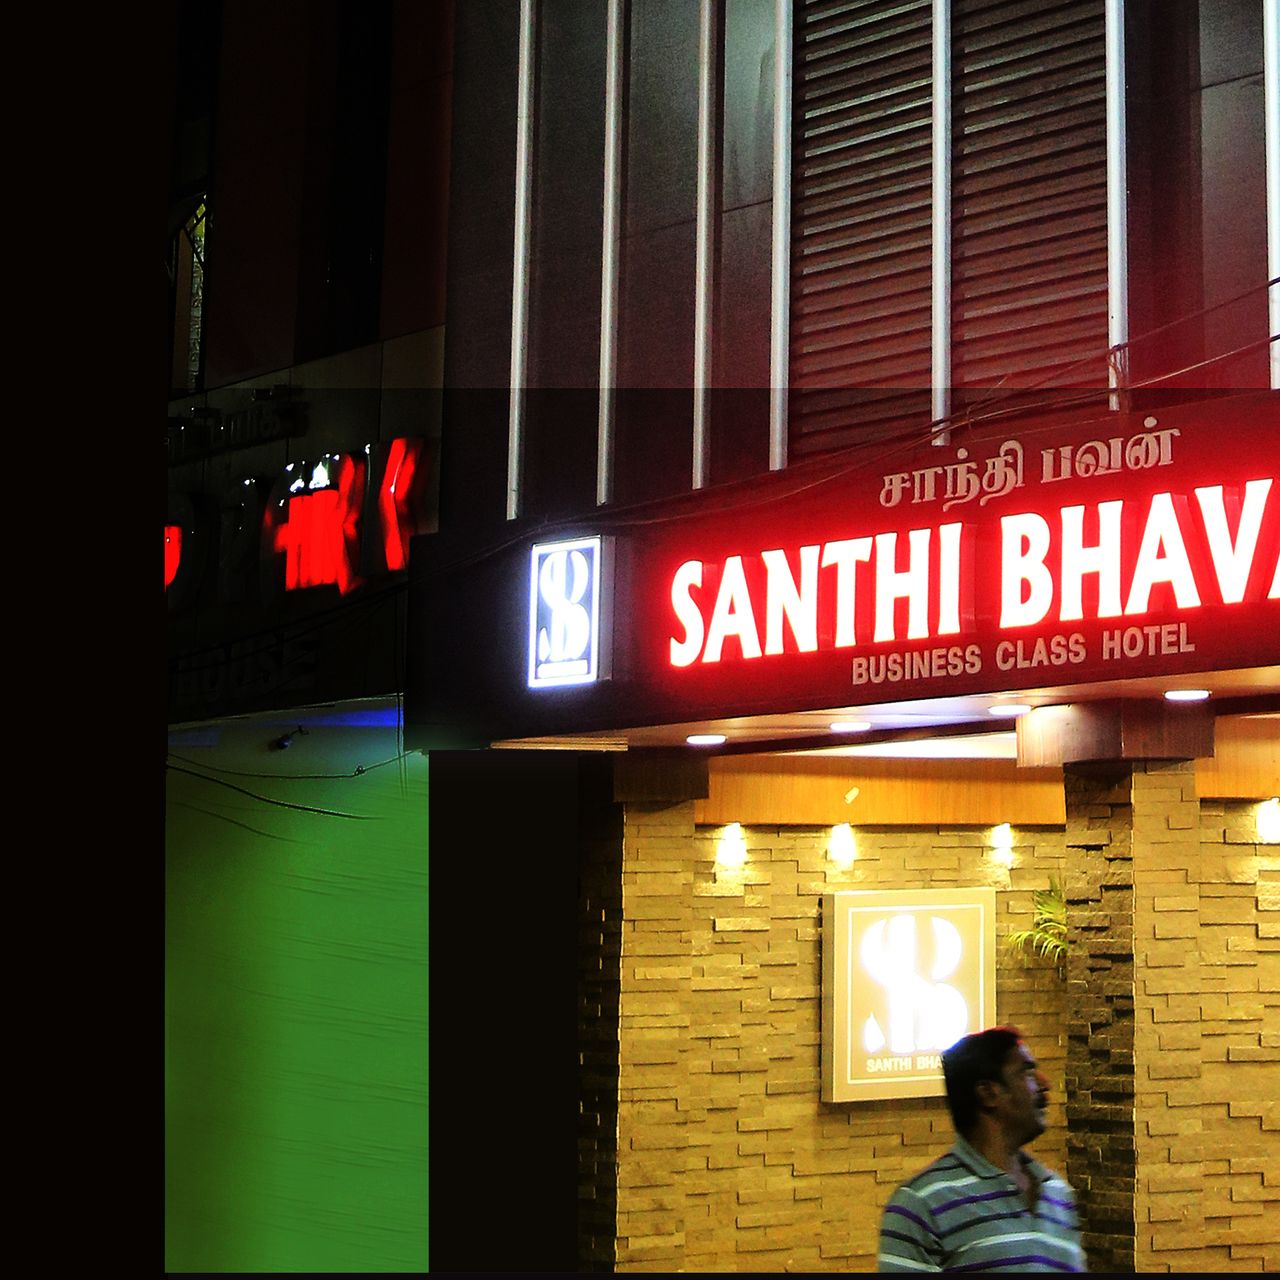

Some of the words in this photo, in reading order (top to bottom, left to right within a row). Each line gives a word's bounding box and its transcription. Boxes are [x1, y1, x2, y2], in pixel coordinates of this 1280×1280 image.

[879, 440, 1025, 511] சாந்தி
[1041, 416, 1181, 483] பவன்
[669, 522, 963, 668] SANTHI
[852, 645, 982, 685] BUSINESS
[996, 633, 1086, 670] CLASS
[1102, 623, 1196, 660] HOTEL
[866, 1057, 912, 1072] SANTHI
[916, 1055, 943, 1070] BHA
